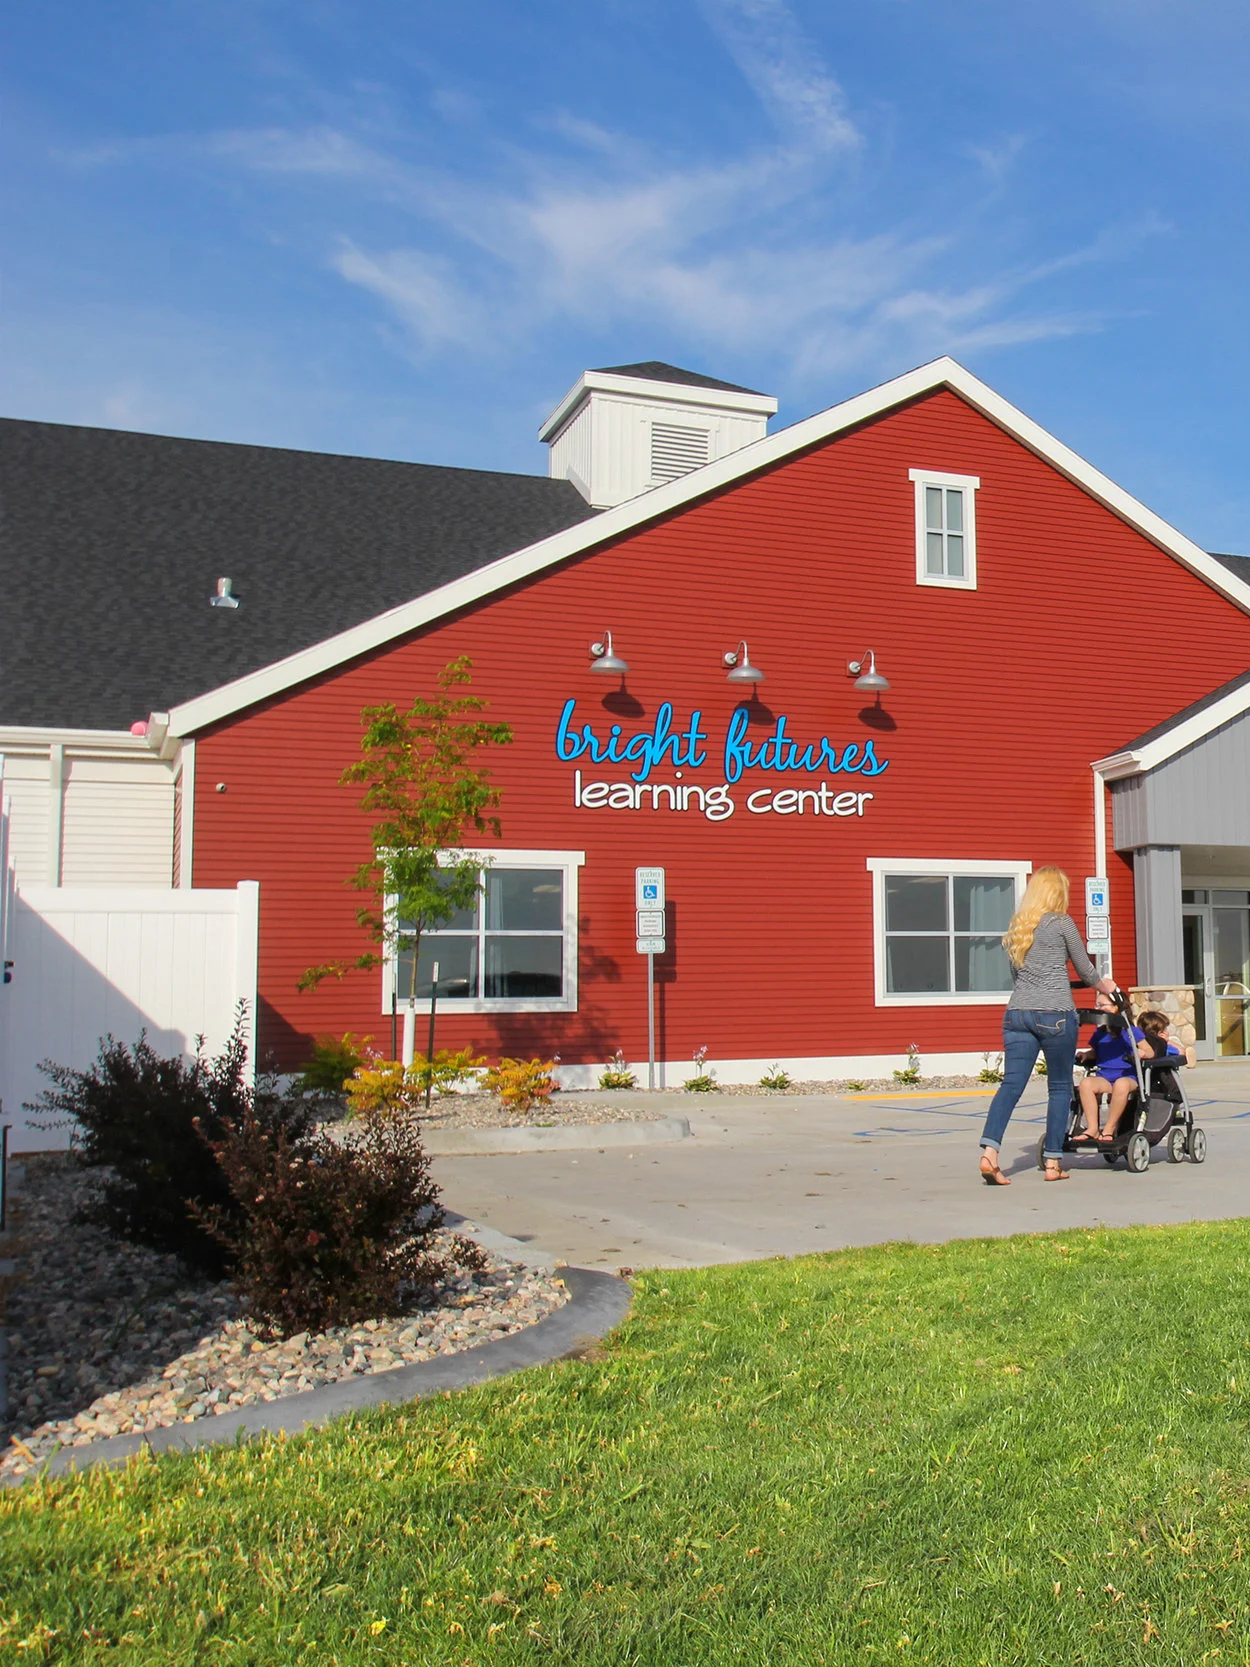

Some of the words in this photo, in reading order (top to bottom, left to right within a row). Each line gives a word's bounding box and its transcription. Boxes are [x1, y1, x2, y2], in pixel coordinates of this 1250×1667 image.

[556, 698, 707, 783] bright
[724, 708, 889, 783] futures
[574, 769, 736, 821] learning
[746, 781, 874, 817] center
